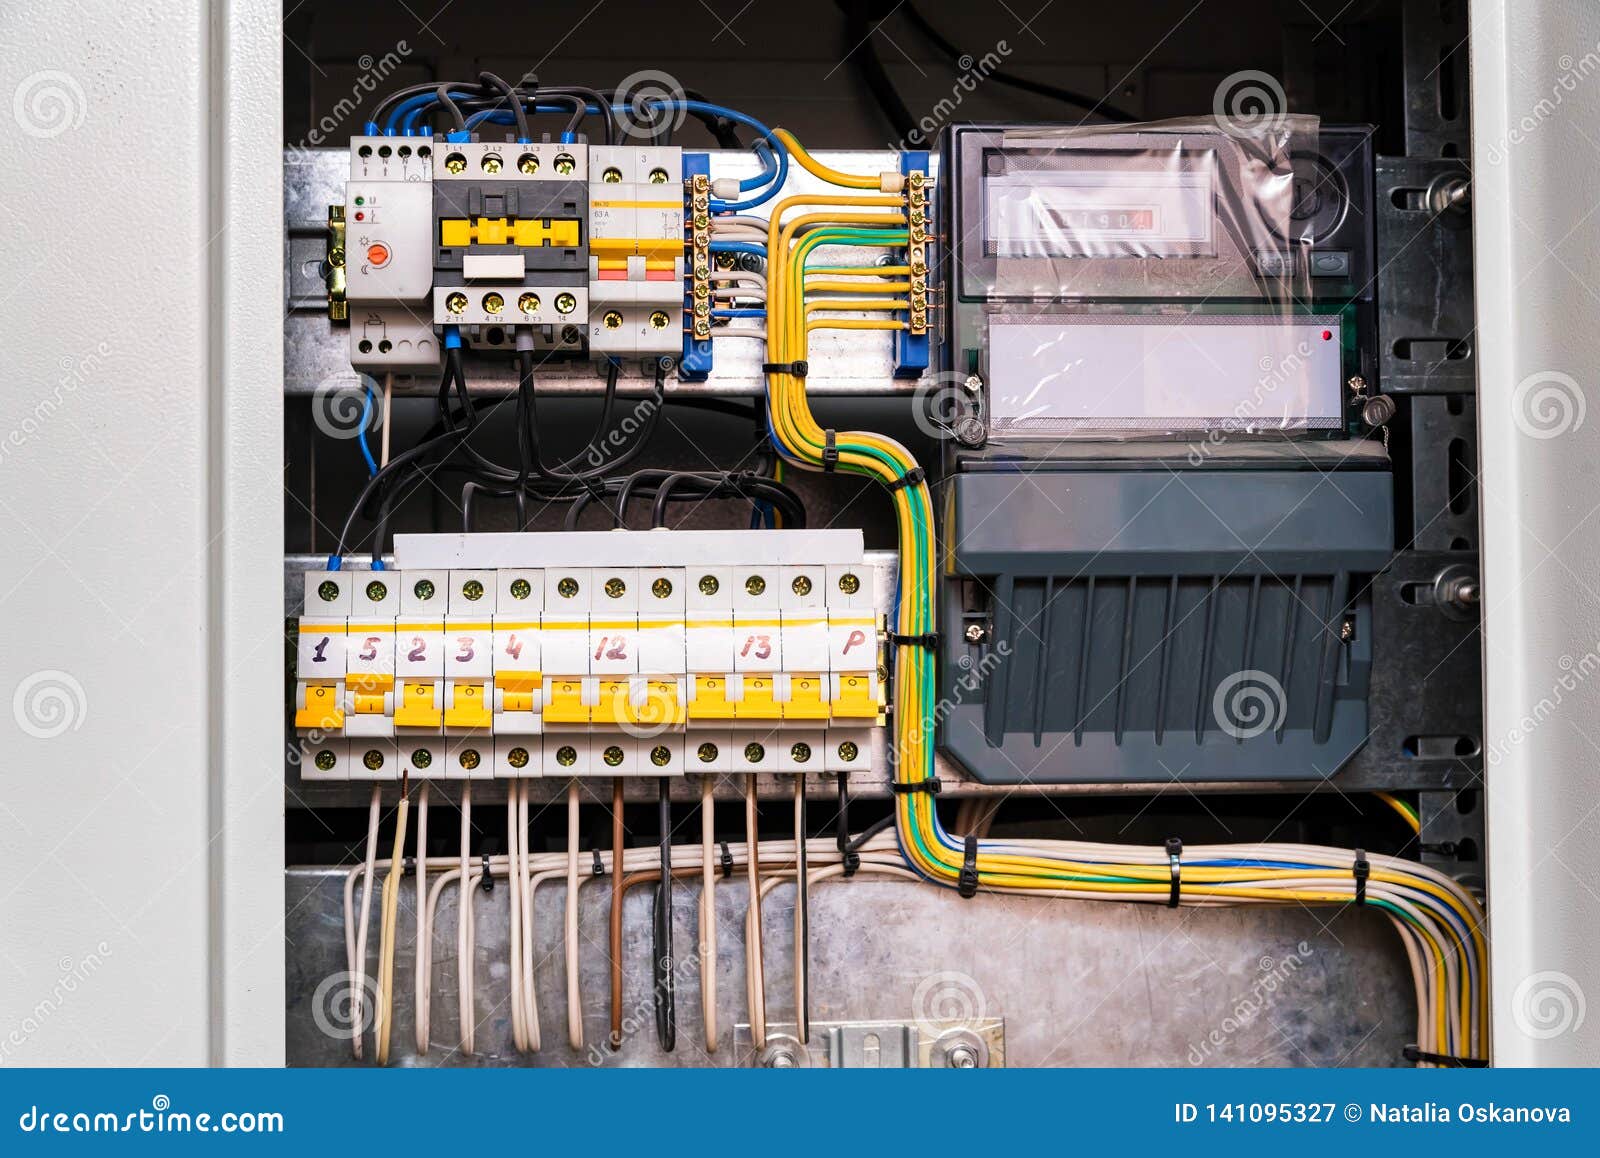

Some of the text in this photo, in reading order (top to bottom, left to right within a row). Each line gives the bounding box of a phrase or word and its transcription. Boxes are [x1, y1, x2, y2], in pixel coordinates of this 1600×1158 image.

[641, 154, 647, 163] 3
[594, 210, 603, 218] 63
[594, 328, 600, 336] 2
[641, 328, 647, 336] 4
[312, 636, 330, 662] 1
[359, 637, 381, 661] 5
[408, 637, 426, 662] 2
[456, 637, 475, 662] 3
[505, 634, 524, 660] 4
[594, 635, 627, 661] 12
[741, 635, 772, 660] 13
